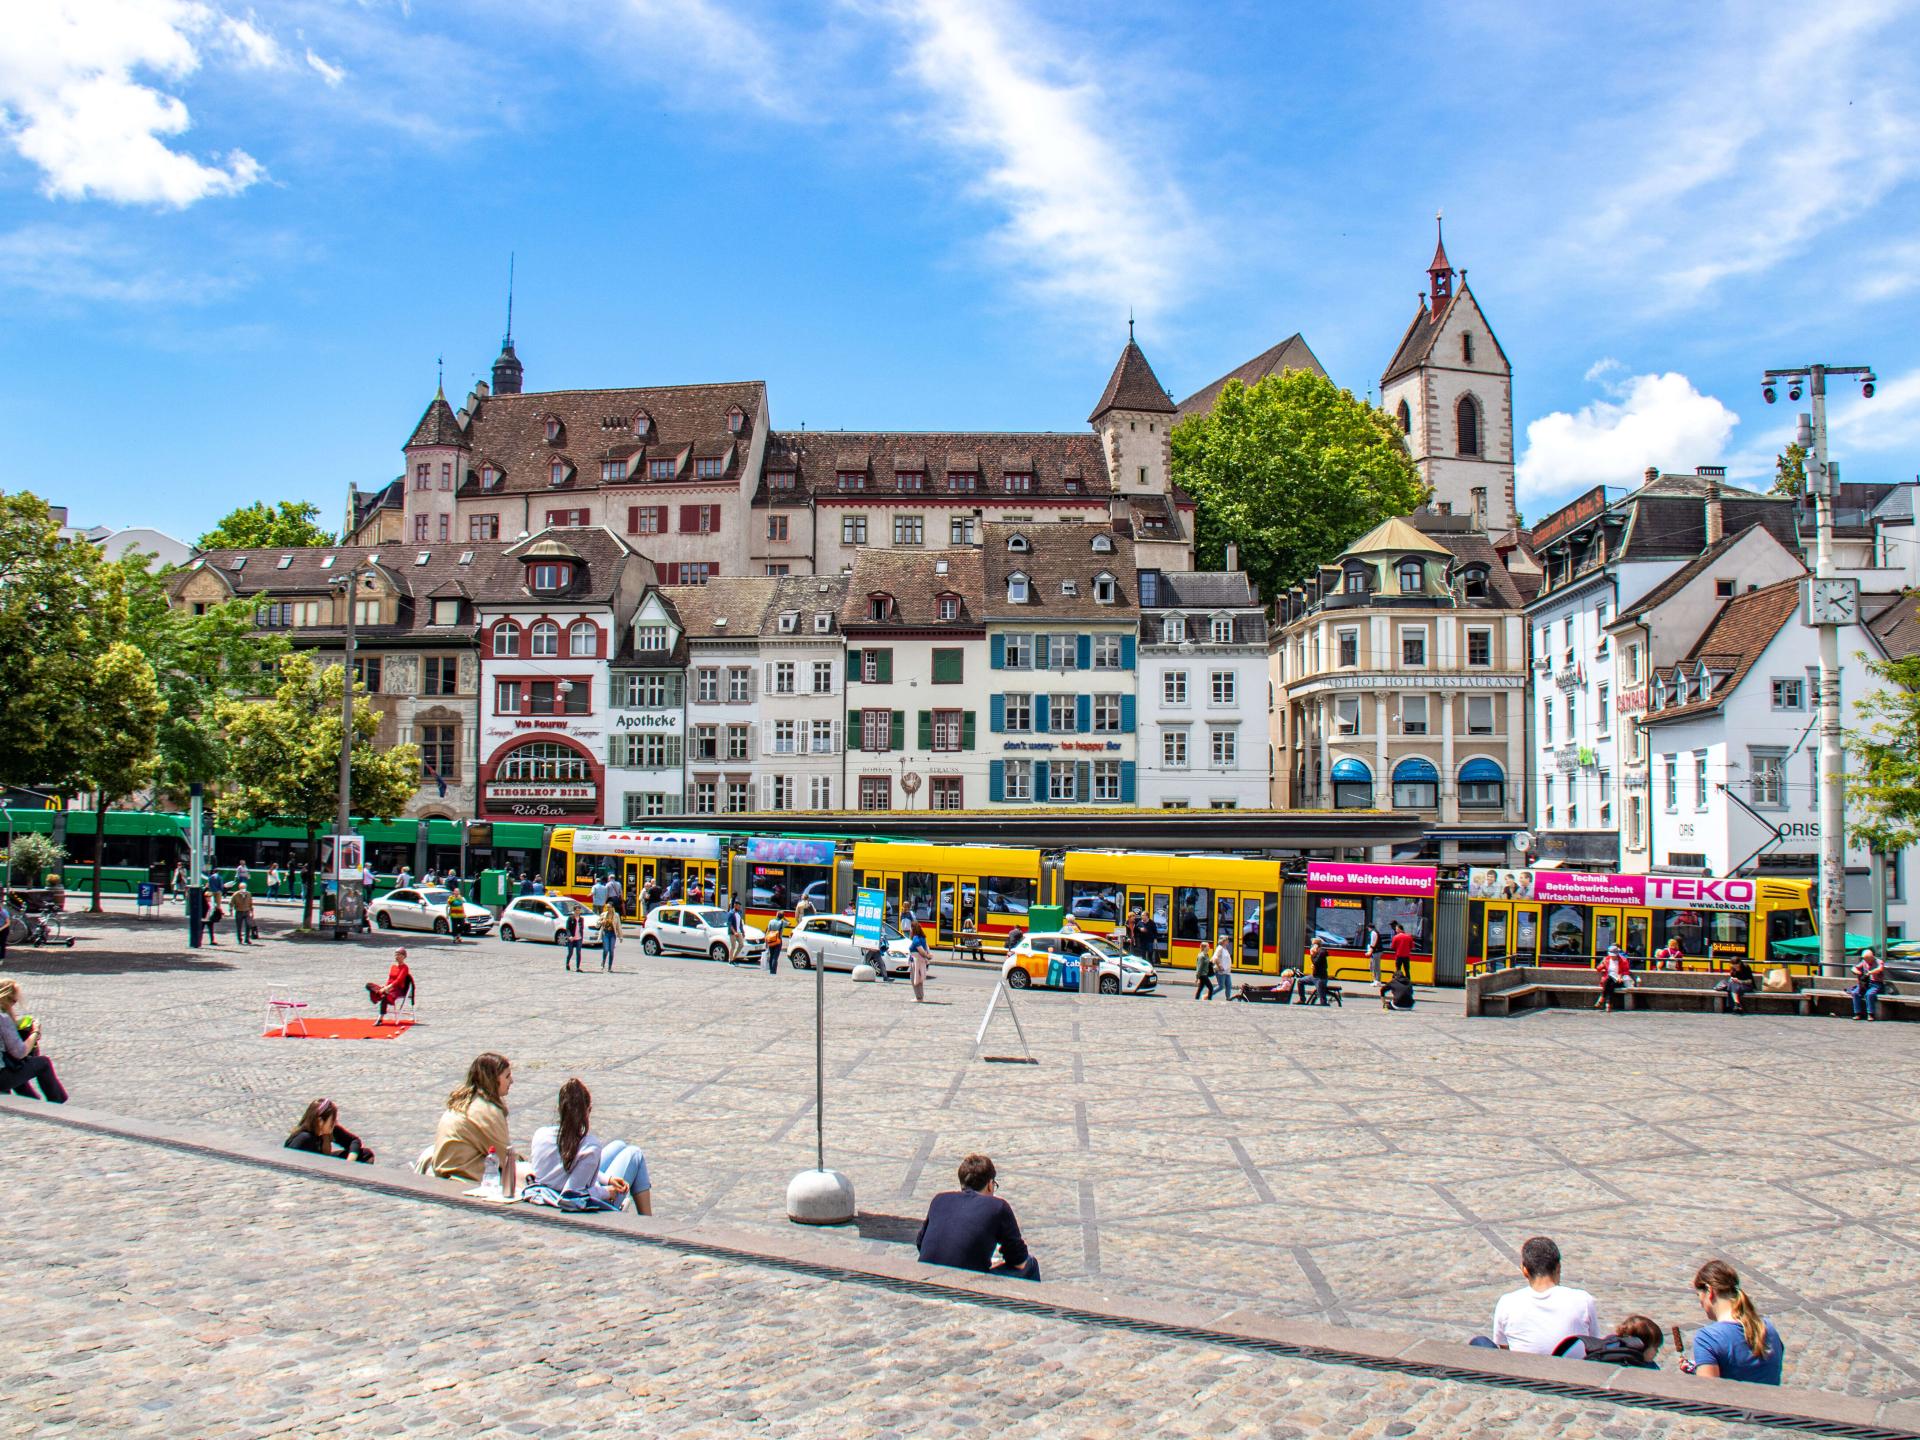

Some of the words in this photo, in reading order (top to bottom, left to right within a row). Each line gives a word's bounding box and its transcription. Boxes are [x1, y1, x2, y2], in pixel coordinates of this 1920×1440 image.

[1385, 677, 1425, 688] HOTEL
[1433, 677, 1521, 688] RESTAURANT
[616, 715, 676, 729] Apotheke
[1061, 741, 1074, 750] be
[493, 789, 556, 797] ZIEGELHOF
[560, 789, 588, 797] BIER
[512, 804, 537, 815] Rio
[537, 804, 566, 815] Bar
[1680, 824, 1694, 836] ORIS
[1778, 823, 1819, 836] ORIS
[1310, 872, 1344, 883] Meine
[1347, 873, 1432, 888] Weiterbildung!
[1571, 874, 1608, 883] Technik
[1545, 883, 1634, 894] Betriebswirtschaft
[1648, 878, 1753, 903] TEKO
[1538, 892, 1640, 905] Wirtschaftsinformatik
[1689, 901, 1750, 911] www.teko.ch
